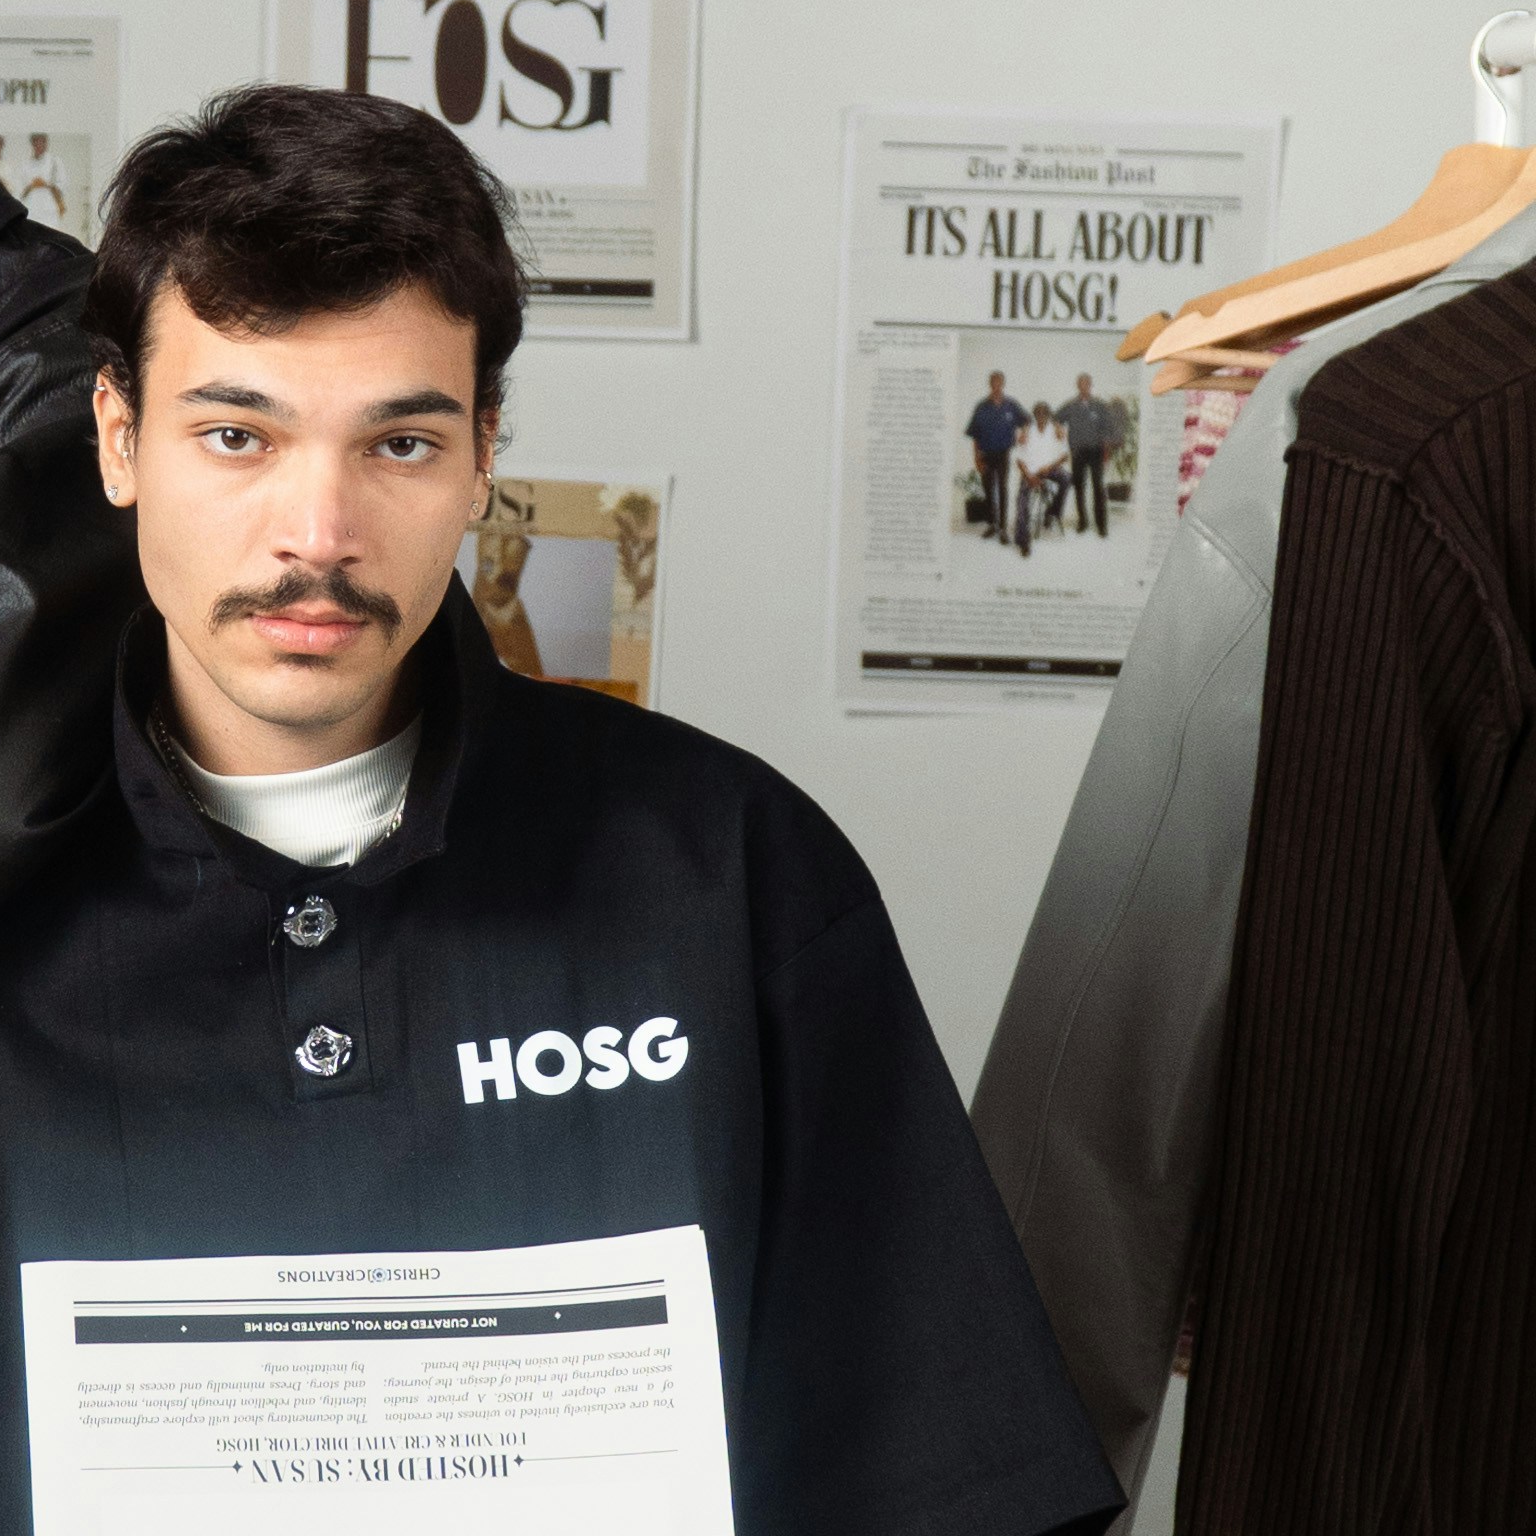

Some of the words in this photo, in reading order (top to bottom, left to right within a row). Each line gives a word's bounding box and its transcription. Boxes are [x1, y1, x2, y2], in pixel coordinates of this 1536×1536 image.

[979, 208, 1055, 260] ALL
[1069, 210, 1213, 265] ABOUT
[992, 269, 1118, 323] HOSG!
[457, 1017, 689, 1104] HOSG
[244, 1322, 262, 1333] ME
[265, 1322, 289, 1332] FOR
[291, 1321, 349, 1332] CURATED
[352, 1318, 382, 1331] YOU,
[384, 1320, 408, 1331] FOR
[411, 1318, 468, 1330] CURATED
[471, 1317, 497, 1328] NOT
[608, 1347, 651, 1359] process
[654, 1348, 671, 1358] the
[483, 1359, 521, 1370] behind
[524, 1357, 558, 1369] vision
[561, 1355, 579, 1365] the
[582, 1354, 605, 1365] and
[292, 1364, 348, 1374] invitation
[351, 1361, 365, 1373] by
[421, 1361, 459, 1372] brand.
[462, 1361, 480, 1371] the
[632, 1365, 672, 1377] session
[515, 1374, 547, 1385] ritual
[551, 1373, 567, 1383] the
[572, 1367, 629, 1381] capturing
[206, 1380, 265, 1392] minimally
[306, 1379, 339, 1390] story.
[343, 1380, 366, 1390] and
[435, 1379, 453, 1388] the
[499, 1374, 512, 1387] of
[662, 1379, 674, 1392] of
[77, 1382, 122, 1394] directly
[125, 1383, 135, 1393] is
[139, 1382, 176, 1391] access
[179, 1382, 202, 1393] and
[269, 1382, 302, 1391] Dress
[562, 1385, 606, 1398] chapter
[615, 1384, 638, 1393] new
[647, 1383, 655, 1391] a
[319, 1395, 366, 1407] identity,
[383, 1395, 419, 1407] studio
[427, 1392, 469, 1405] private
[477, 1394, 486, 1403] A
[495, 1392, 533, 1404] HOSG.
[543, 1391, 553, 1400] in
[78, 1400, 138, 1410] movement
[142, 1397, 189, 1411] fashion,
[191, 1397, 237, 1410] through
[240, 1398, 290, 1409] rebellion
[293, 1398, 316, 1408] and
[630, 1400, 649, 1408] are
[653, 1398, 675, 1409] You
[458, 1409, 500, 1420] witness
[505, 1409, 516, 1420] to
[520, 1407, 560, 1419] invited
[564, 1402, 626, 1417] exclusively
[163, 1414, 205, 1427] explore
[208, 1416, 230, 1426] will
[233, 1415, 264, 1426] shoot
[267, 1412, 344, 1425] documentary
[346, 1414, 367, 1424] The
[385, 1412, 432, 1423] creation
[436, 1411, 453, 1422] the
[216, 1438, 259, 1452] HOSG
[264, 1436, 348, 1451] DIRECTOR,
[353, 1435, 430, 1450] CREATIVE
[435, 1434, 447, 1447] &
[450, 1432, 526, 1447] FOUNDER
[250, 1459, 340, 1483] SUSAN
[347, 1459, 389, 1482] BY:
[397, 1455, 509, 1482] HOSTED
